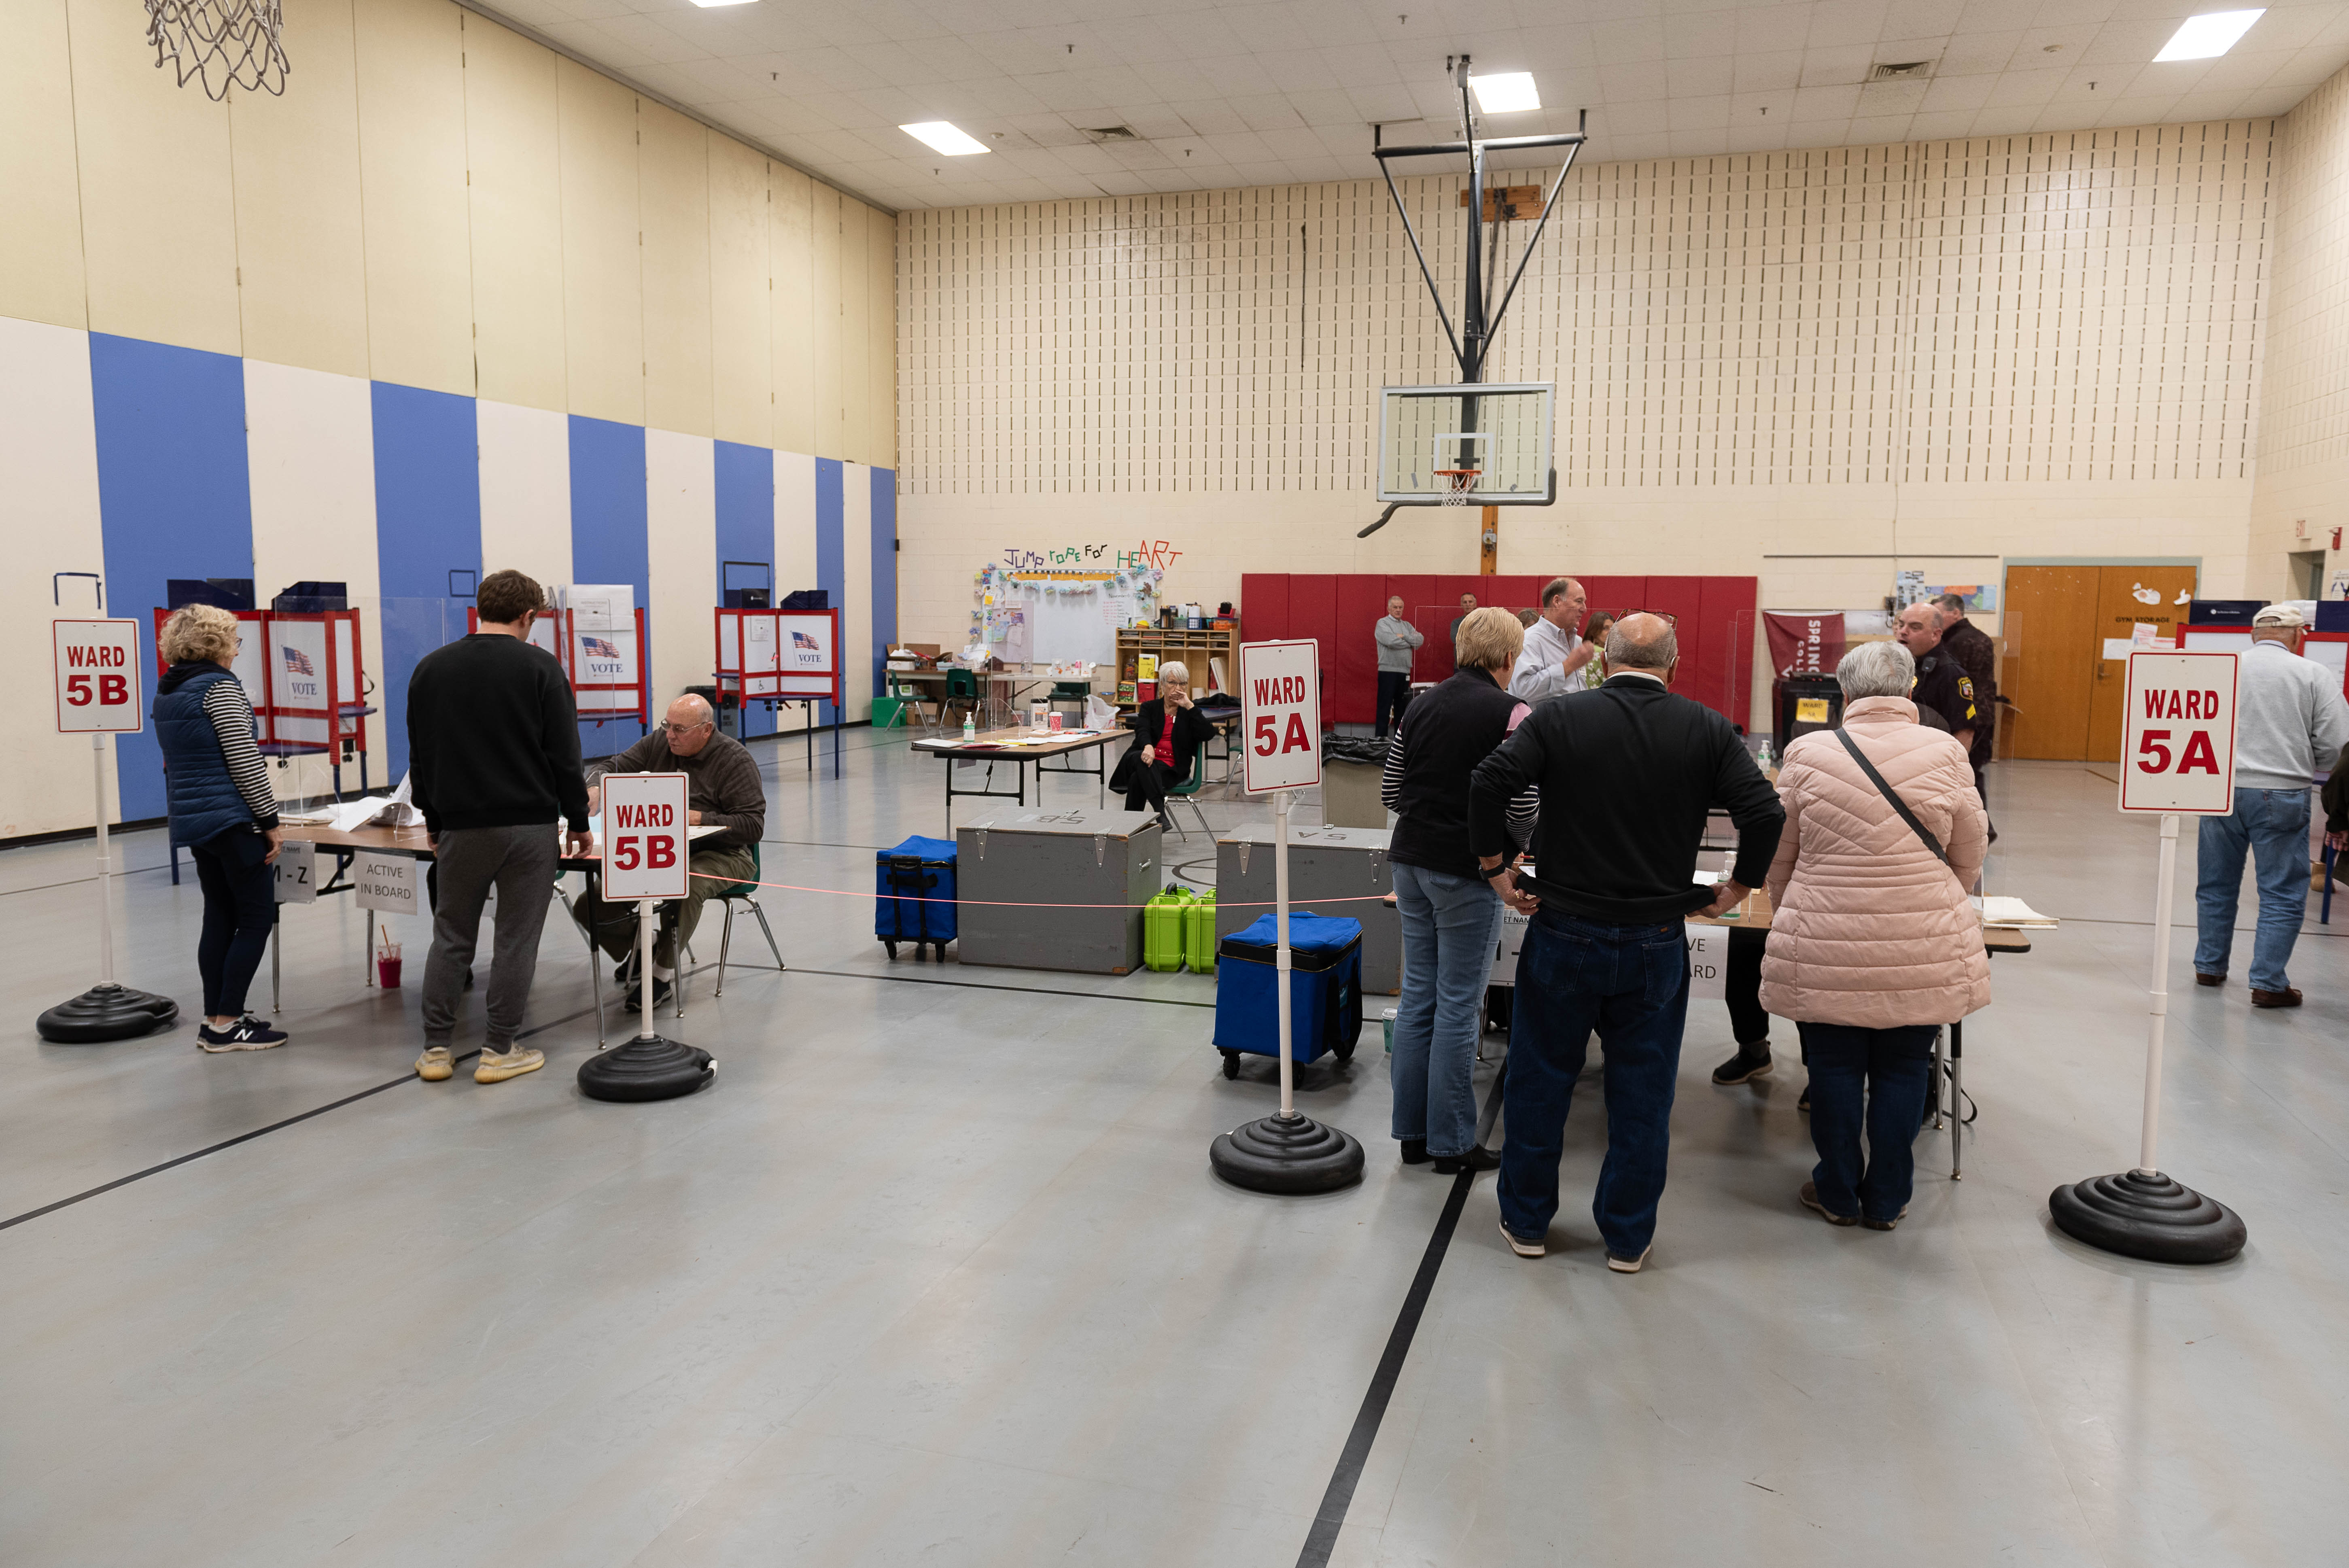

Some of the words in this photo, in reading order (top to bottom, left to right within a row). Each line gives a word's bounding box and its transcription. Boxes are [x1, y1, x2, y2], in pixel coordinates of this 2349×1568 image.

[1004, 549, 1044, 569] JUMP
[1117, 539, 1183, 571] HEART
[67, 646, 125, 667] WARD
[799, 654, 822, 663] VOTE
[590, 664, 624, 673] VOTE
[67, 675, 128, 706] 5B
[292, 682, 317, 696] VOTE
[1254, 676, 1305, 707] WARD
[2145, 689, 2219, 719] WARD
[1254, 713, 1311, 757] 5A
[2137, 730, 2220, 775] 5A
[616, 804, 673, 828] WARD
[615, 835, 676, 870] 5B
[297, 866, 308, 884] Z
[367, 864, 403, 878] ACTIVE
[361, 883, 371, 895] IN
[375, 885, 411, 900] BOARD
[234, 1029, 254, 1041] N
